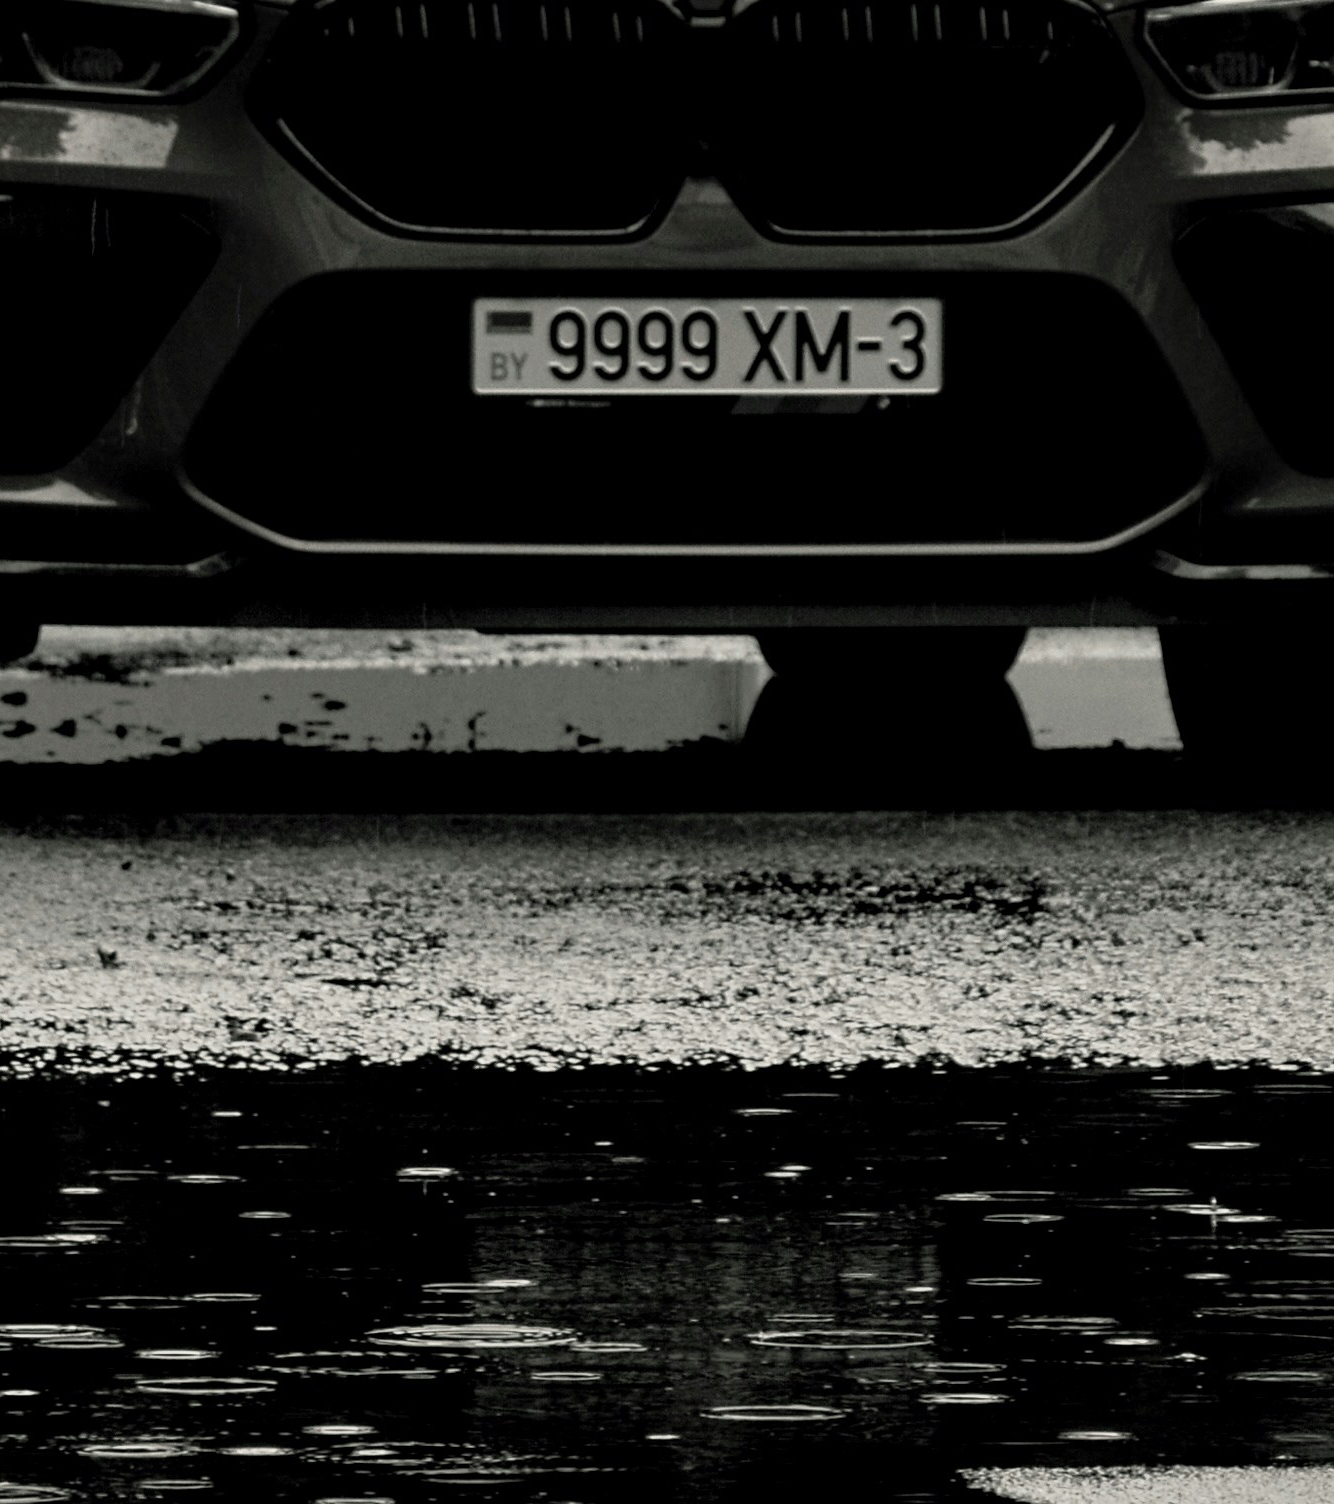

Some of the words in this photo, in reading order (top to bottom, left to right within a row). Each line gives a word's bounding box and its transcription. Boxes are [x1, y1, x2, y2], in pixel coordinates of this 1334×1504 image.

[490, 352, 528, 381] BY
[549, 310, 718, 382] 9999
[743, 310, 926, 382] XM-3
